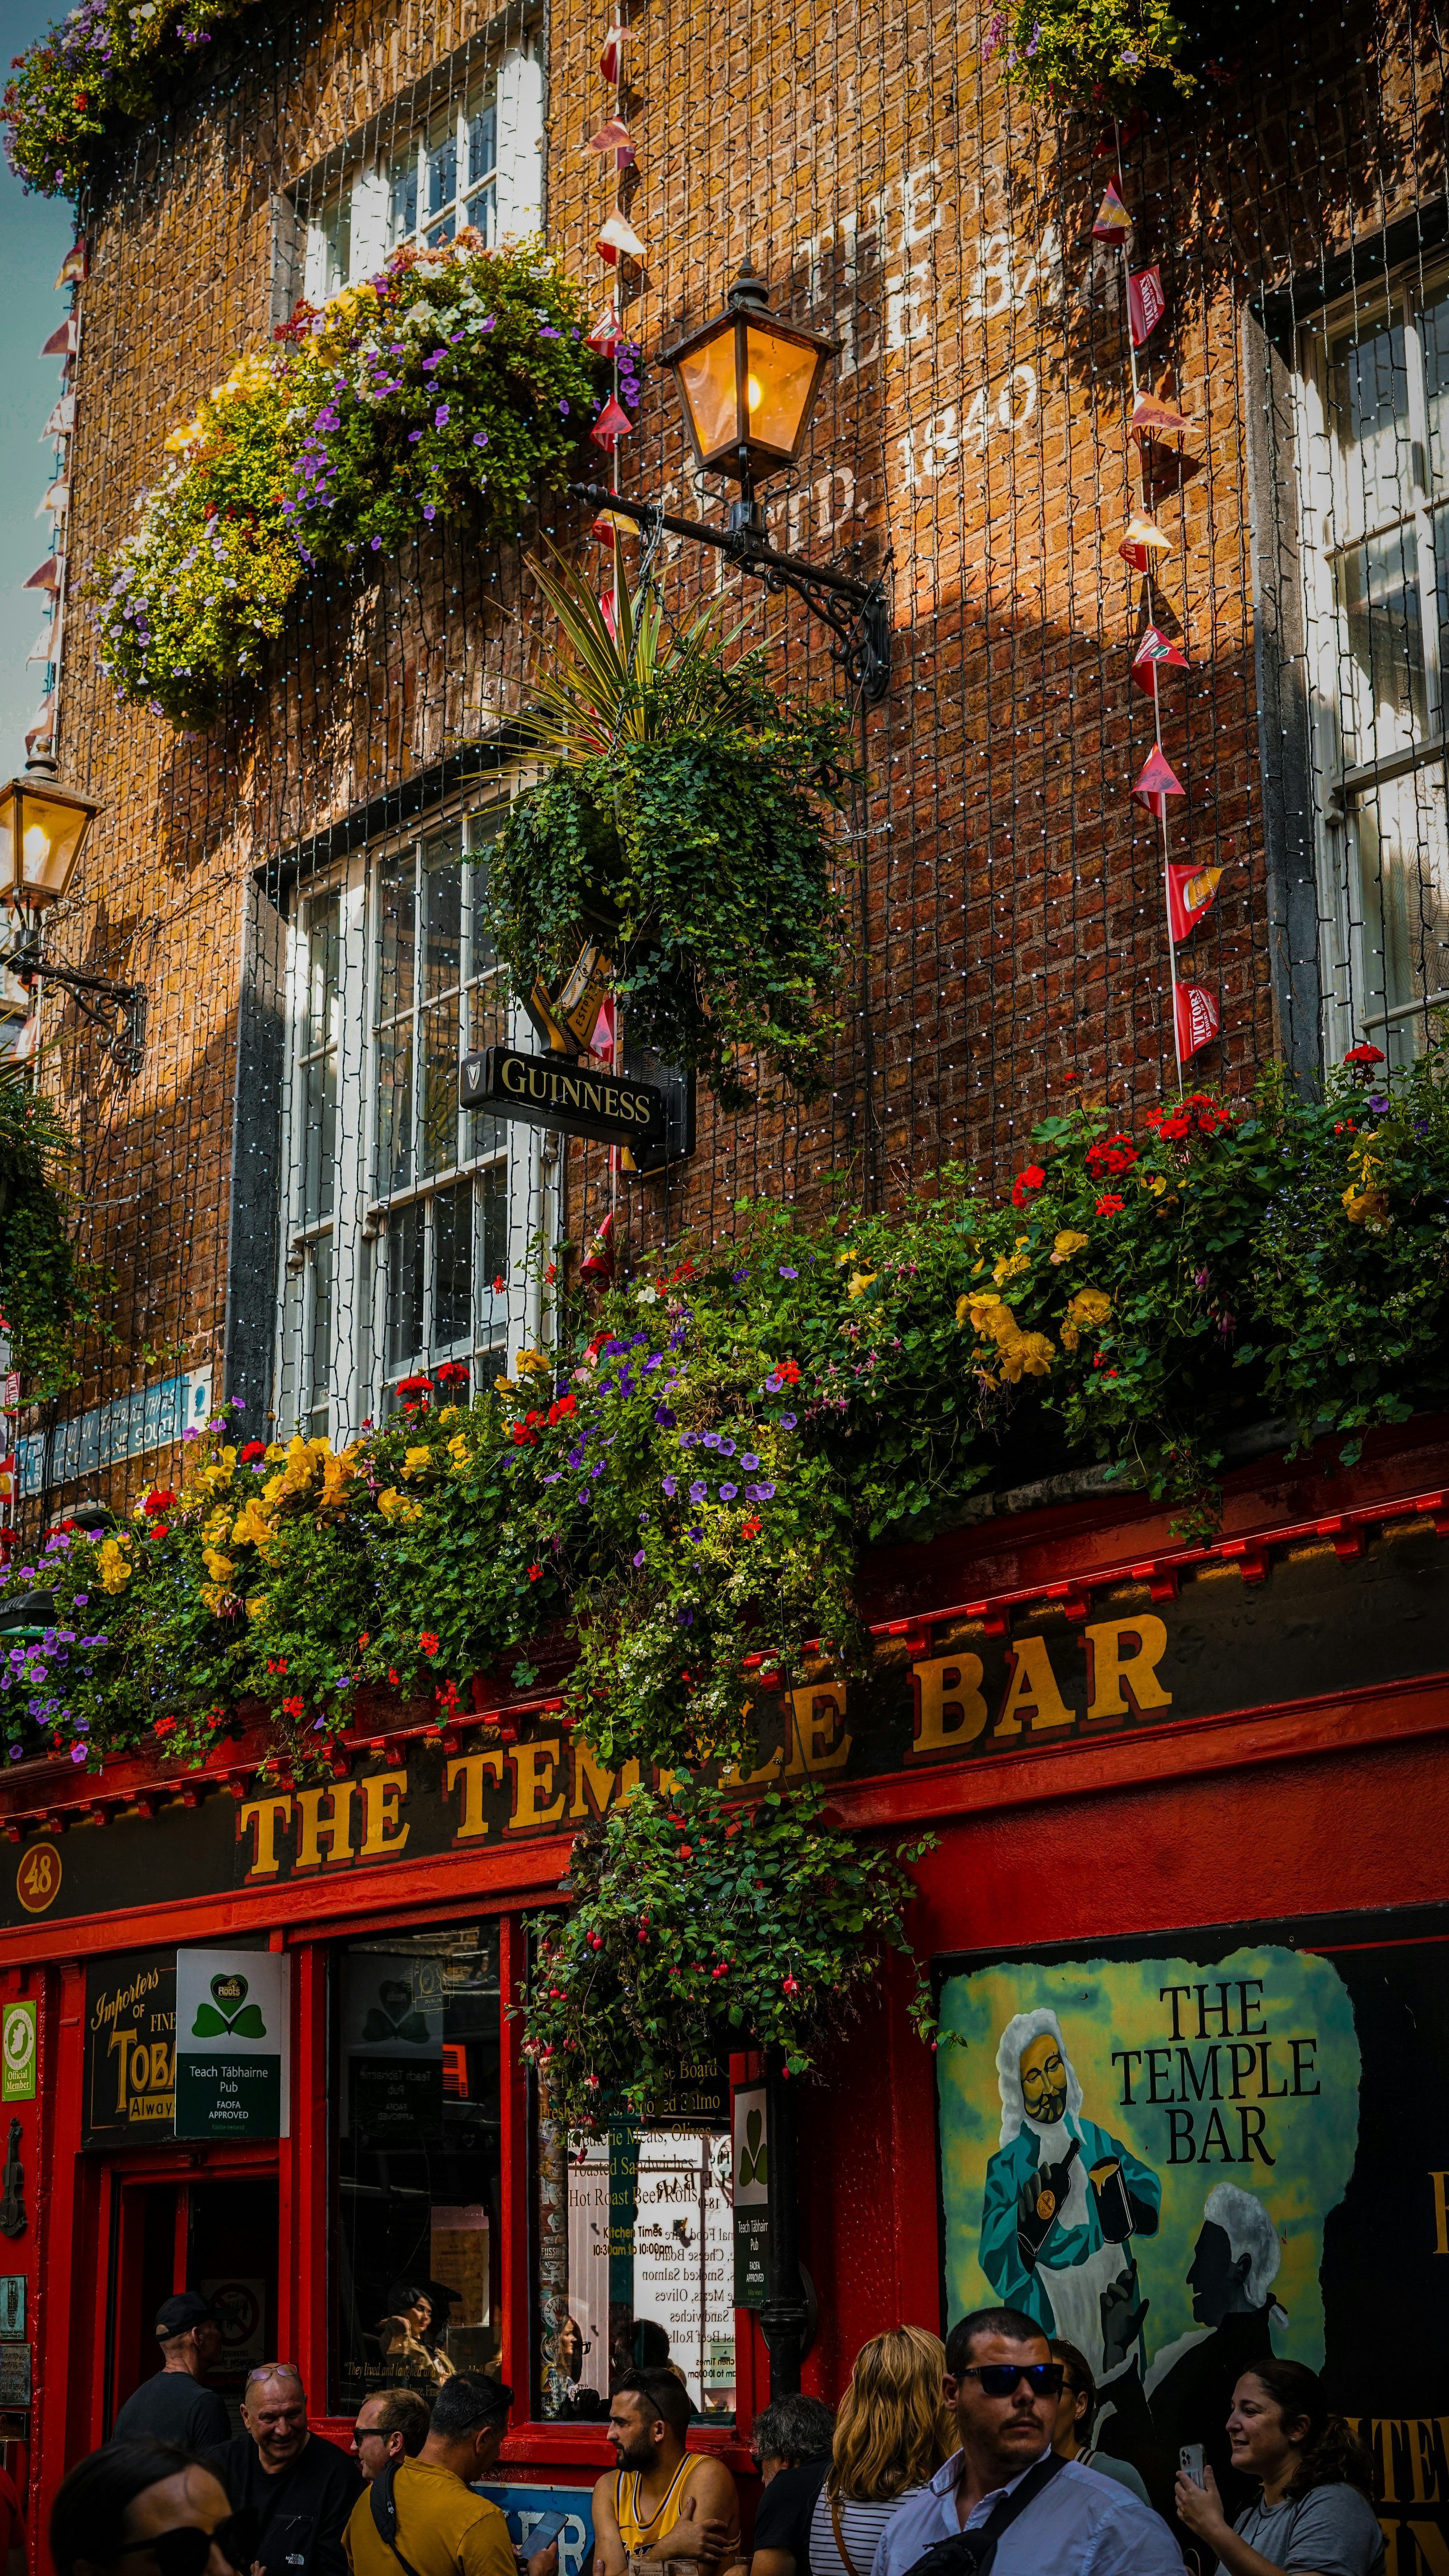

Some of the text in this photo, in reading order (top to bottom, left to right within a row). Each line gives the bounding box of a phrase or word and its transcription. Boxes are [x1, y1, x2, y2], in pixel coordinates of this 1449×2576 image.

[1139, 276, 1155, 330] VICTORY
[897, 364, 1037, 493] 1840
[1188, 989, 1206, 1045] VICTORY
[1203, 1011, 1211, 1031] YOURS
[502, 1058, 651, 1124] GUINNESS
[194, 1385, 206, 1417] 2
[135, 1413, 177, 1447] SOUTH
[240, 1614, 1173, 1875] THE TEMLE BAR
[25, 1854, 52, 1895] 48
[90, 1967, 159, 2031] Importers
[132, 2004, 145, 2019] OF
[1160, 1979, 1268, 2041] THE
[8, 2069, 28, 2080] Official
[189, 2066, 268, 2077] Teach Tábhairne
[679, 2058, 717, 2078] Board
[1112, 2038, 1321, 2106] TEMPLE
[7, 2080, 29, 2091] Member
[220, 2081, 238, 2092] Pub
[539, 2102, 570, 2121] Fresh
[626, 2126, 667, 2145] Meats,
[671, 2123, 710, 2141] Olives
[1166, 2106, 1276, 2167] BAR
[573, 2154, 694, 2177] Toasted Sandwiches
[569, 2184, 697, 2207] Hot Roast Beef Rolls
[603, 2225, 662, 2238] Kitchen Times
[738, 2220, 750, 2233] Teach
[593, 2244, 673, 2257] 10:30am to 10:00pm
[750, 2237, 759, 2251] Pub
[749, 2261, 761, 2270] FAOFA
[746, 2273, 764, 2282] APPROVED
[545, 2298, 557, 2314] LEFT
[364, 2362, 381, 2376] lived
[382, 2362, 395, 2376] and
[396, 2362, 423, 2379] laughed
